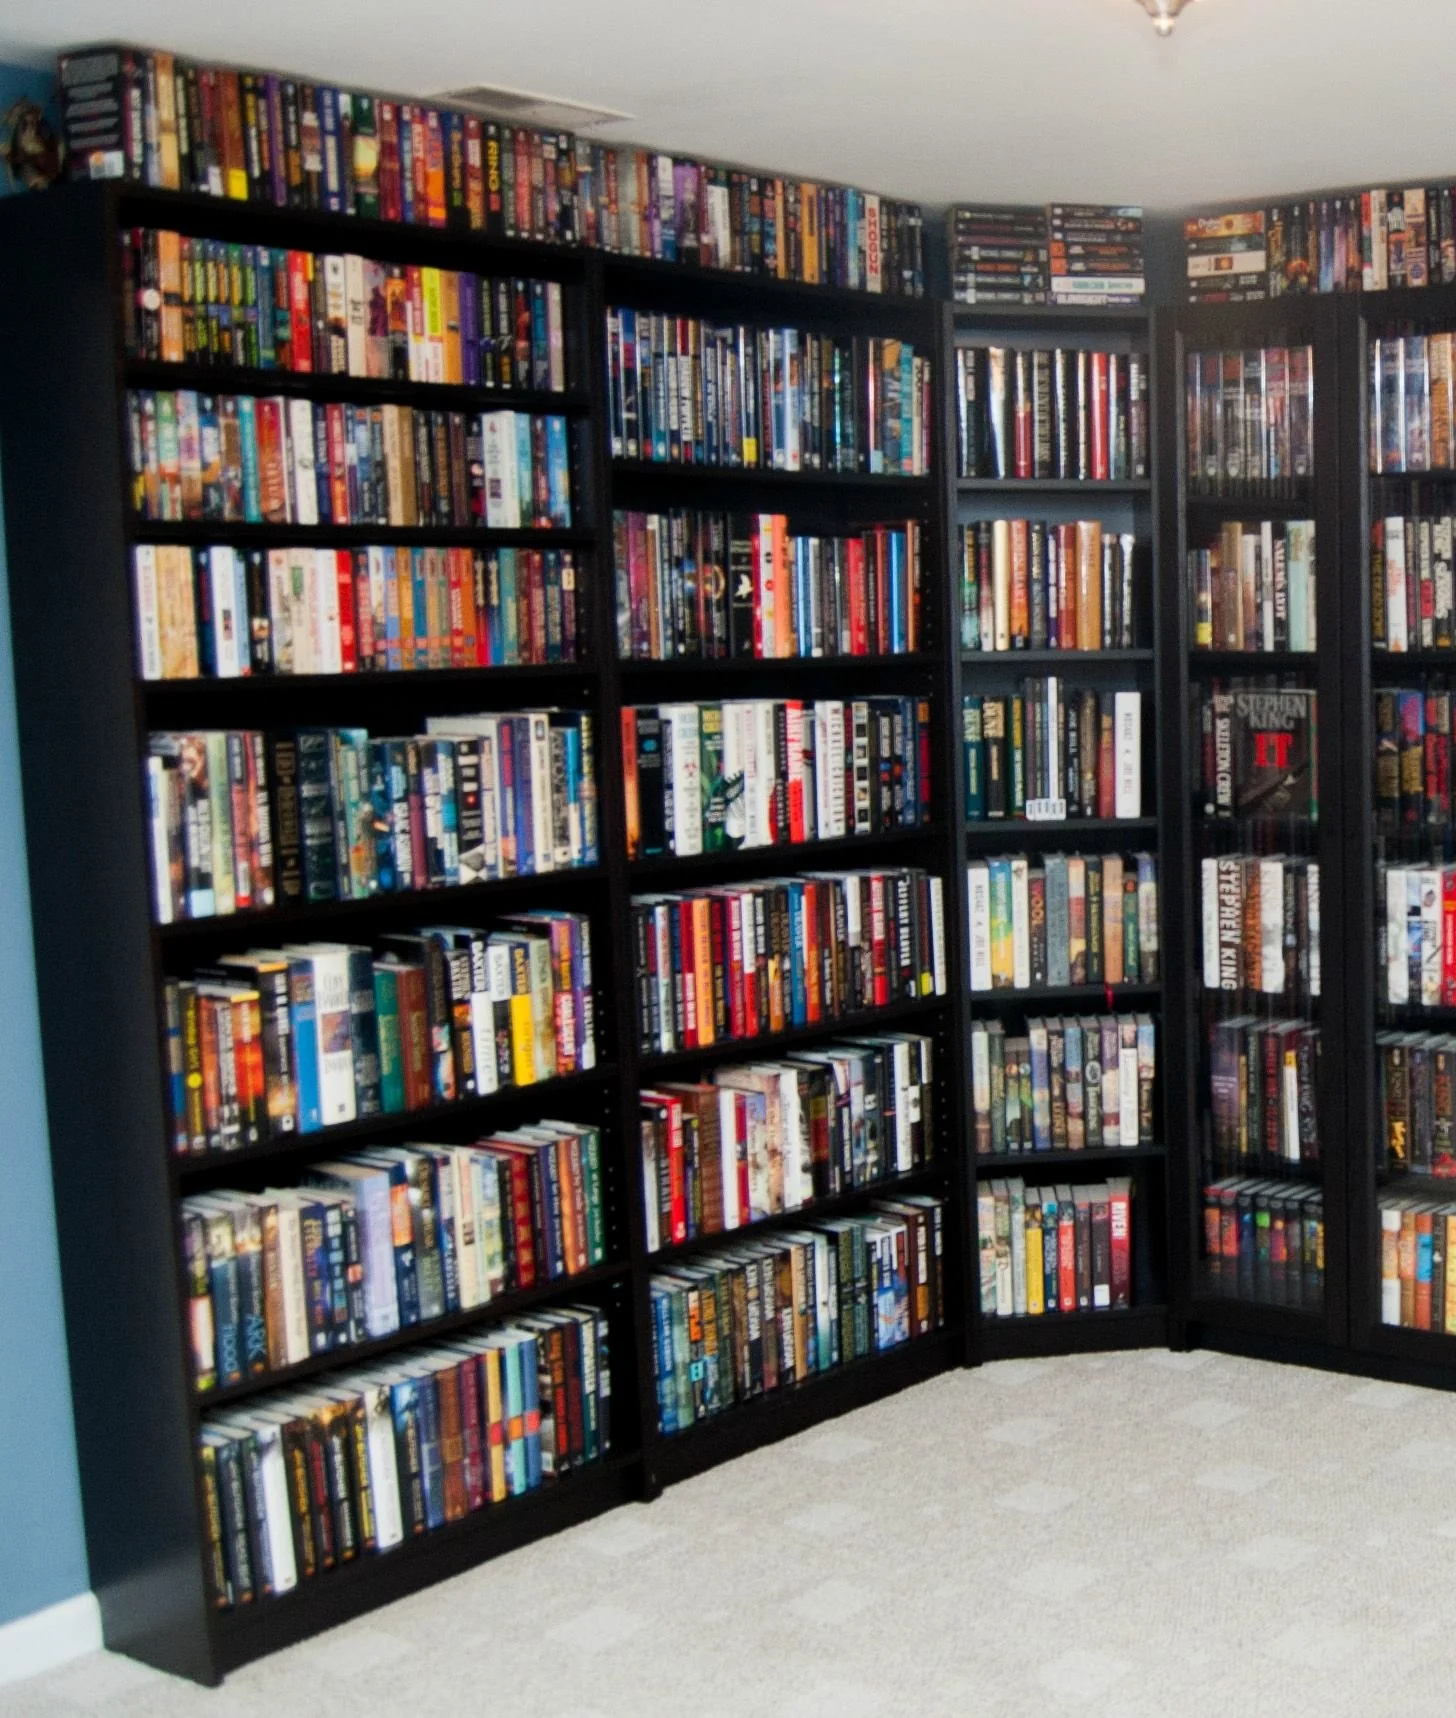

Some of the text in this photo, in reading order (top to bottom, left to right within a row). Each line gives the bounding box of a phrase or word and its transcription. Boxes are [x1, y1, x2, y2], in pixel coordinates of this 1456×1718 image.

[487, 141, 499, 193] RING
[1236, 692, 1307, 719] STEPHEN
[1249, 711, 1295, 731] KING
[1254, 732, 1294, 769] IT
[1219, 860, 1238, 990] STEPHEN KING
[471, 941, 486, 992] BAXTER
[493, 952, 507, 1000] BAXTER
[513, 947, 528, 994] BAXTER
[246, 1315, 265, 1359] ARK
